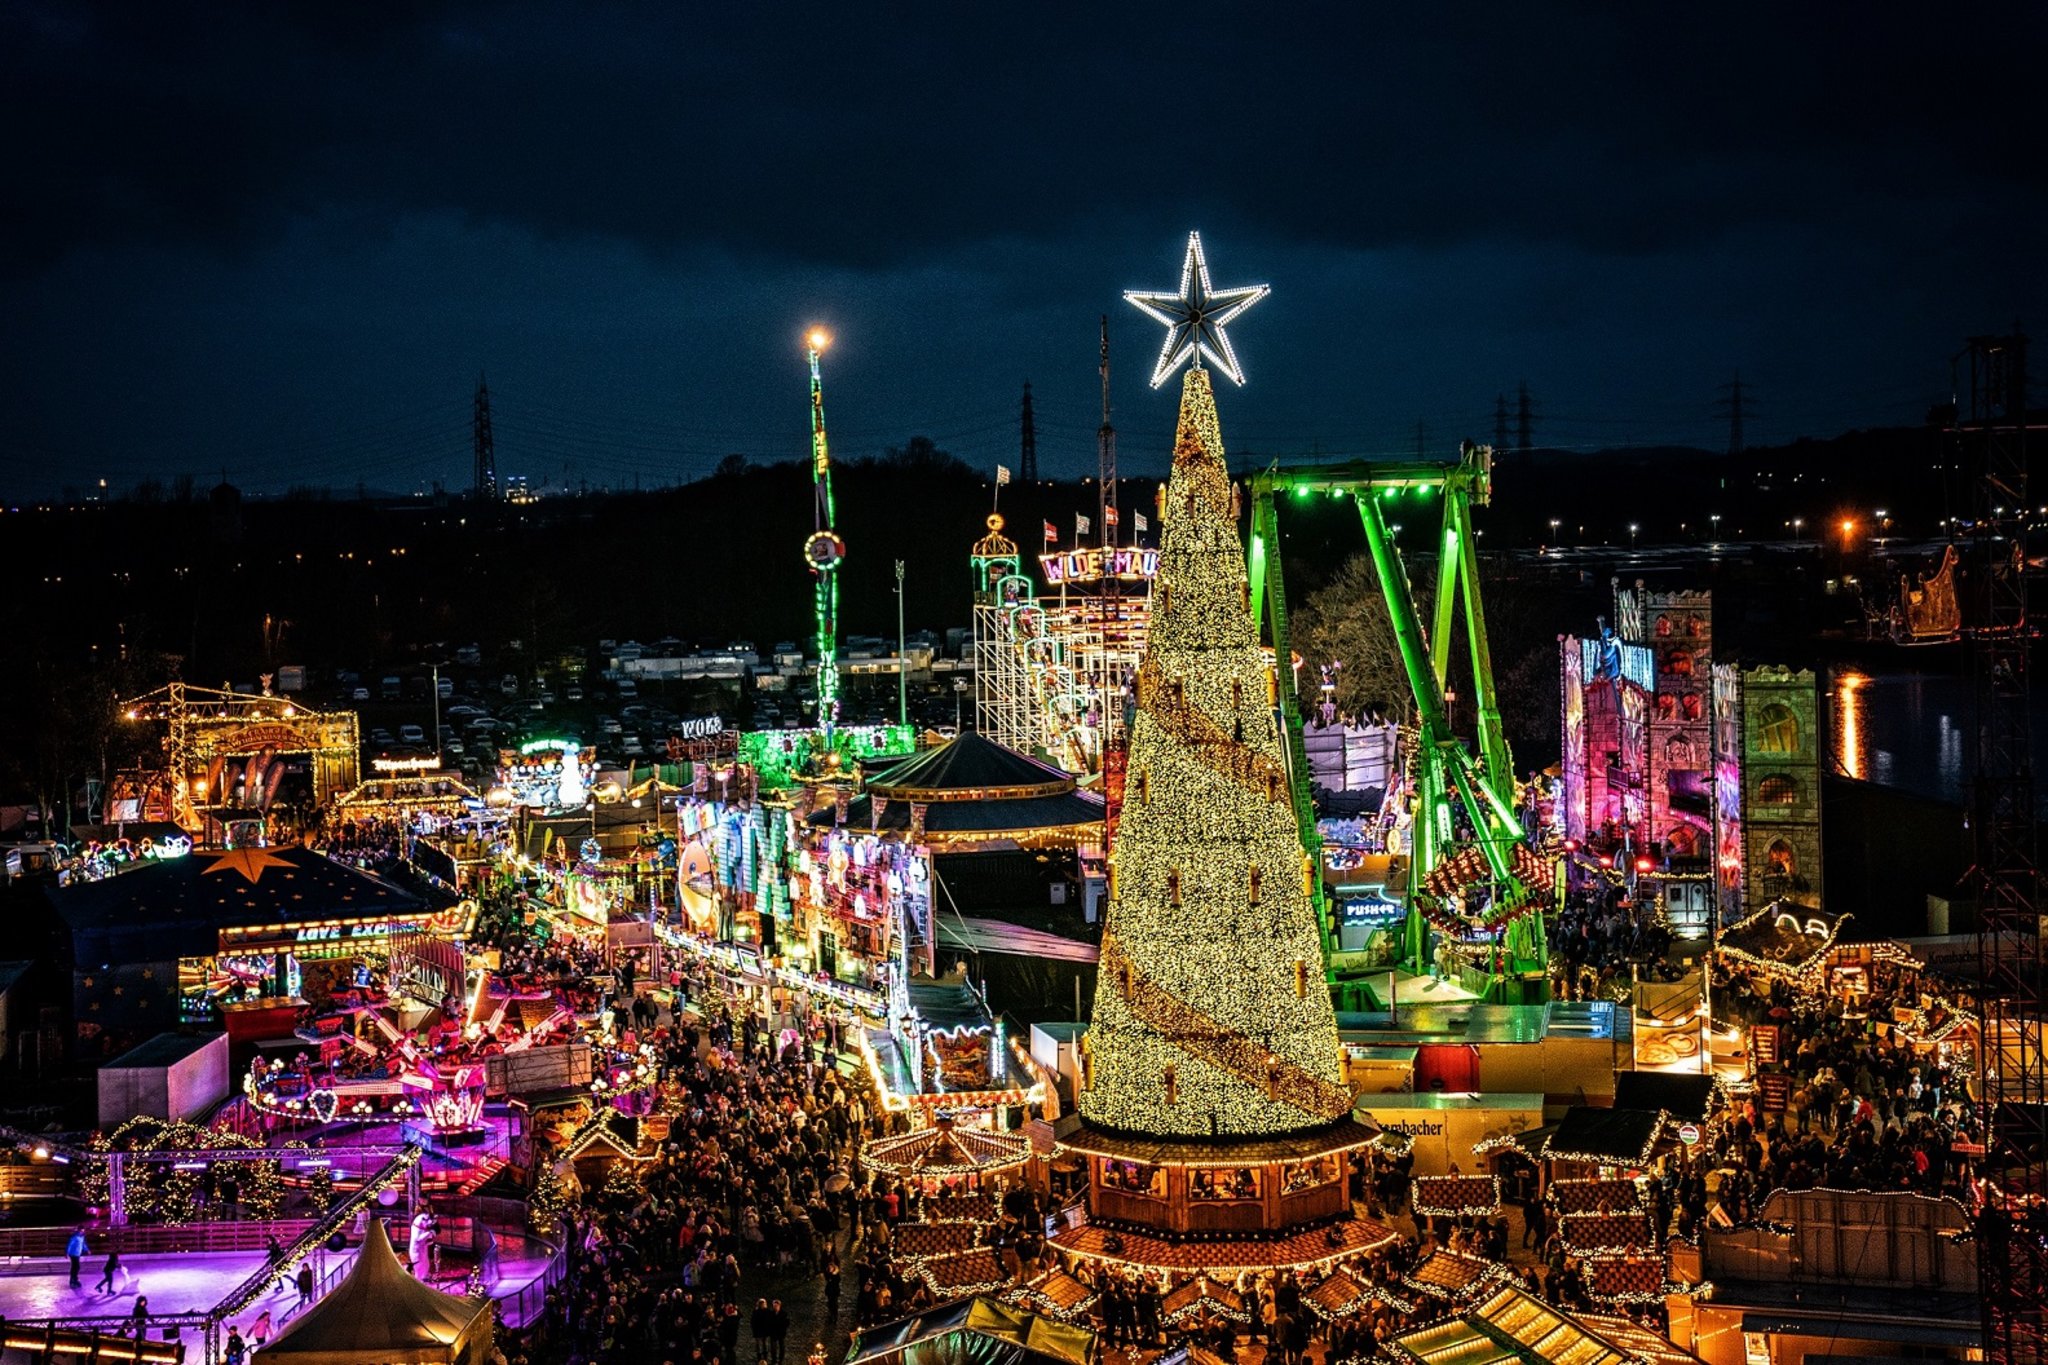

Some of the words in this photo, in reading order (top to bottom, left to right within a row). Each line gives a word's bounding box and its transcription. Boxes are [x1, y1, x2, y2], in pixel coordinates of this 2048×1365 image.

[1045, 552, 1099, 579] WILDE
[1347, 904, 1395, 916] PUSHER
[296, 926, 341, 941] LOVE
